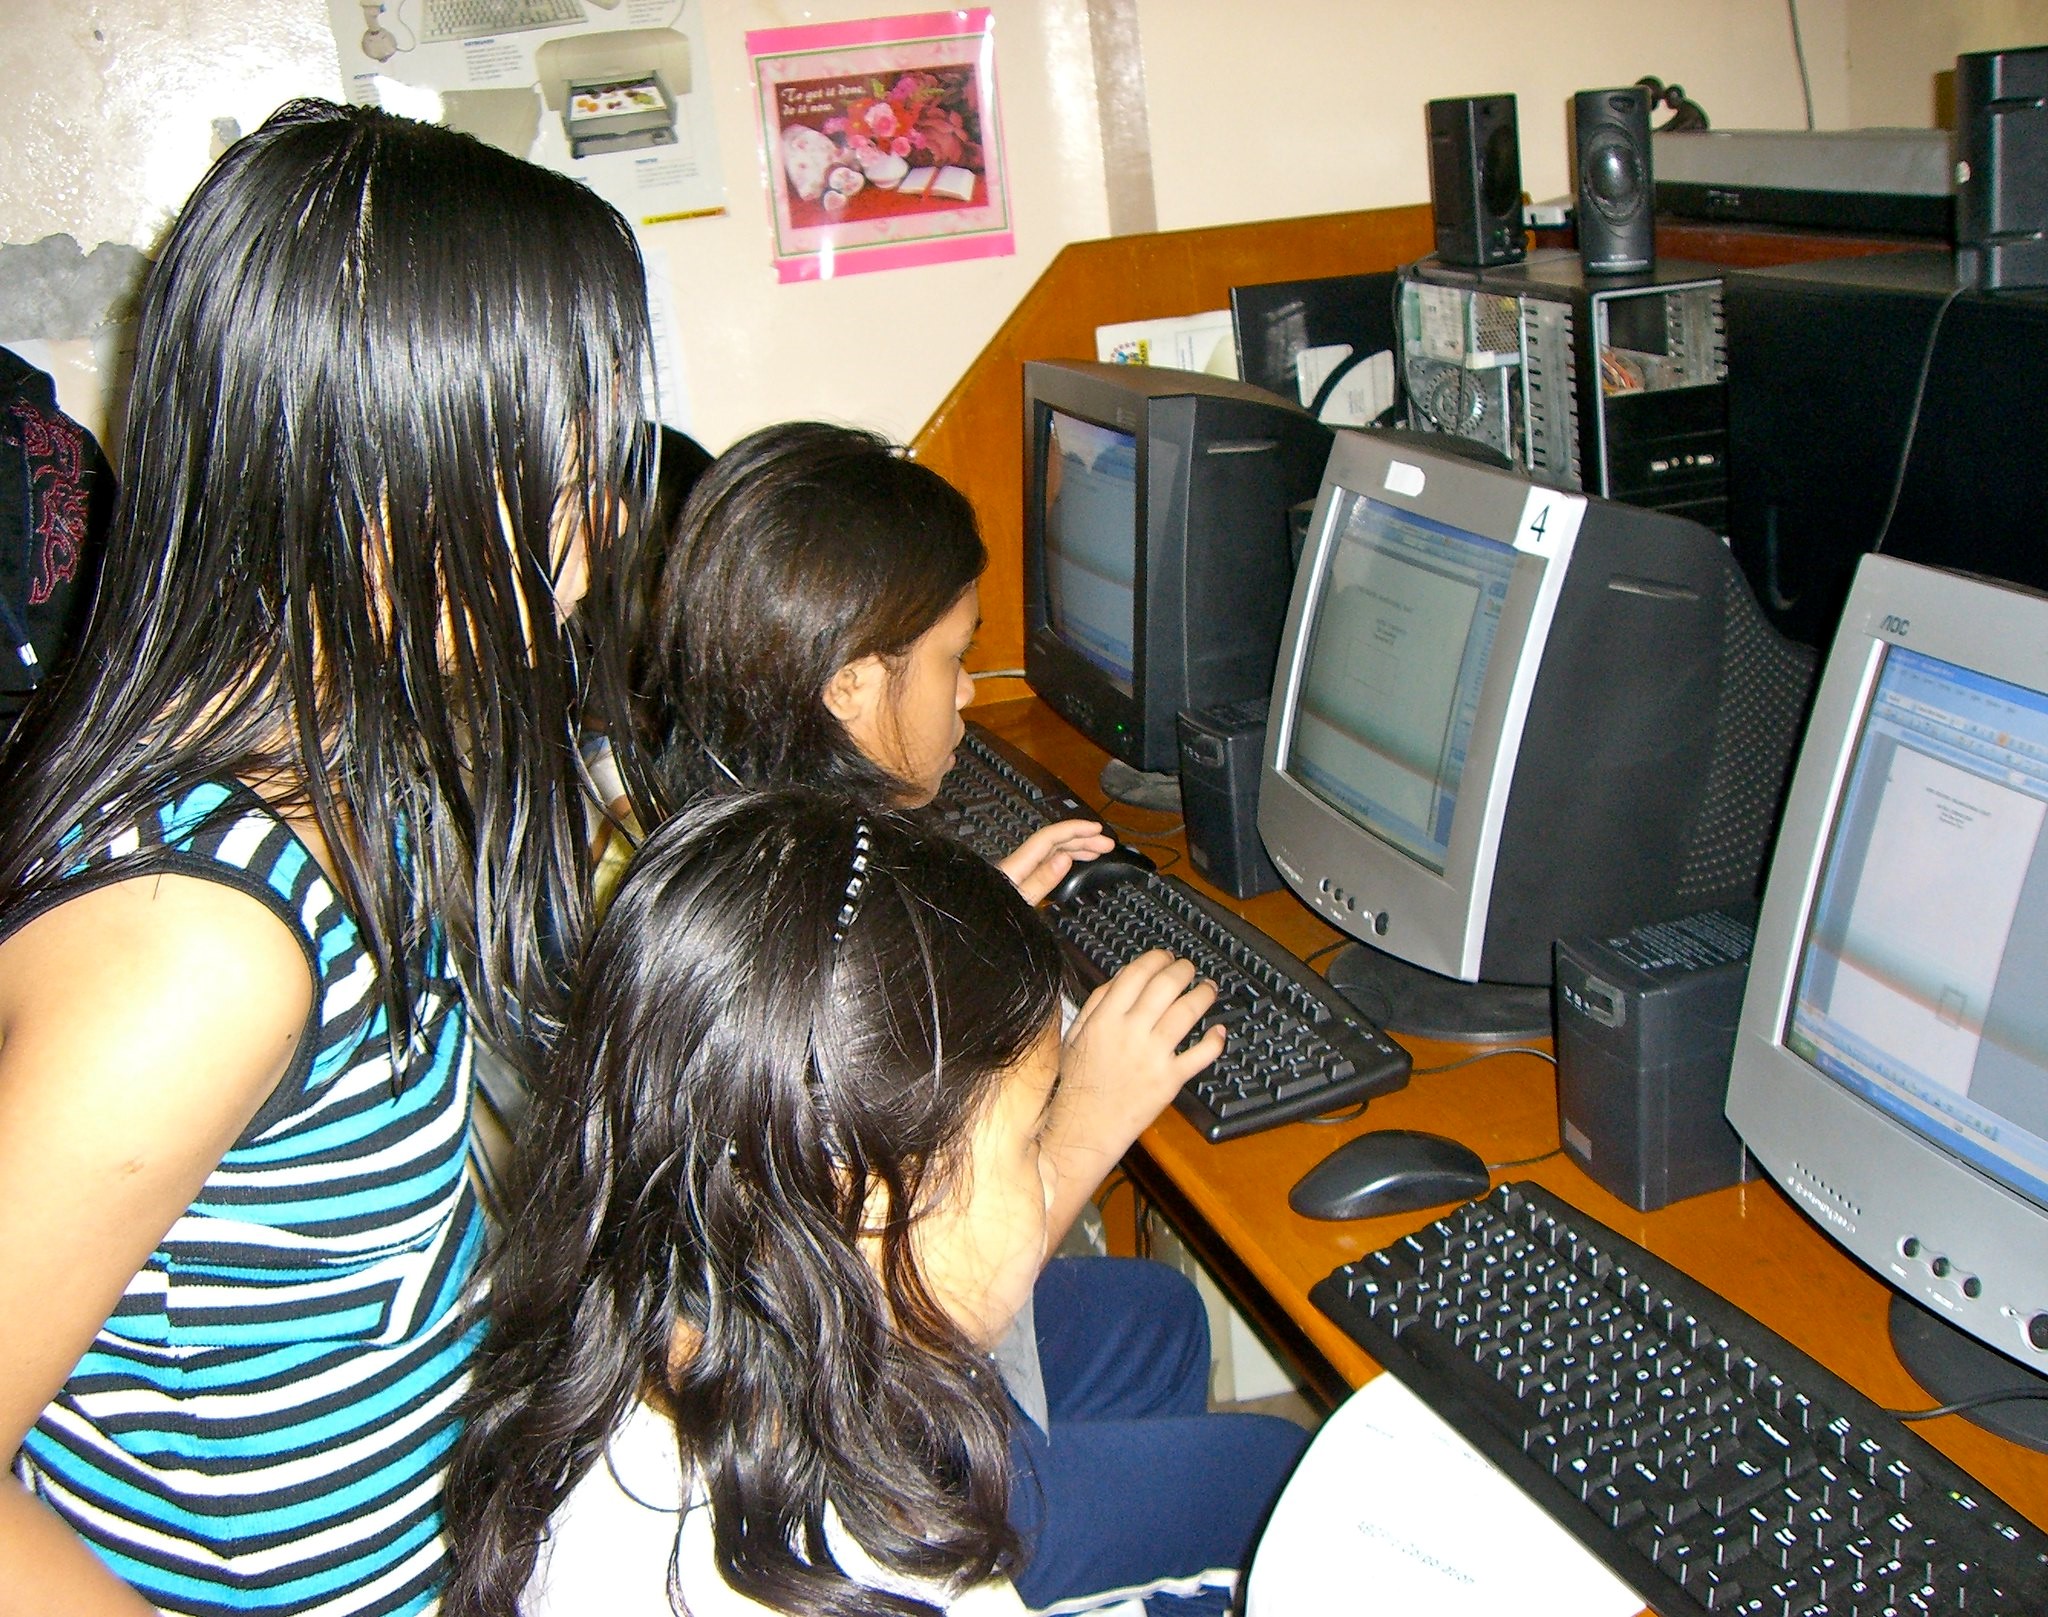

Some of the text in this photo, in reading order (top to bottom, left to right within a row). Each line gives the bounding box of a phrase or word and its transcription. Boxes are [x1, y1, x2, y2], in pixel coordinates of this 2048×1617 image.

[781, 87, 803, 102] To
[805, 88, 823, 103] get
[825, 87, 836, 97] it
[1530, 504, 1550, 542] 4
[1880, 614, 1911, 637] AOC
